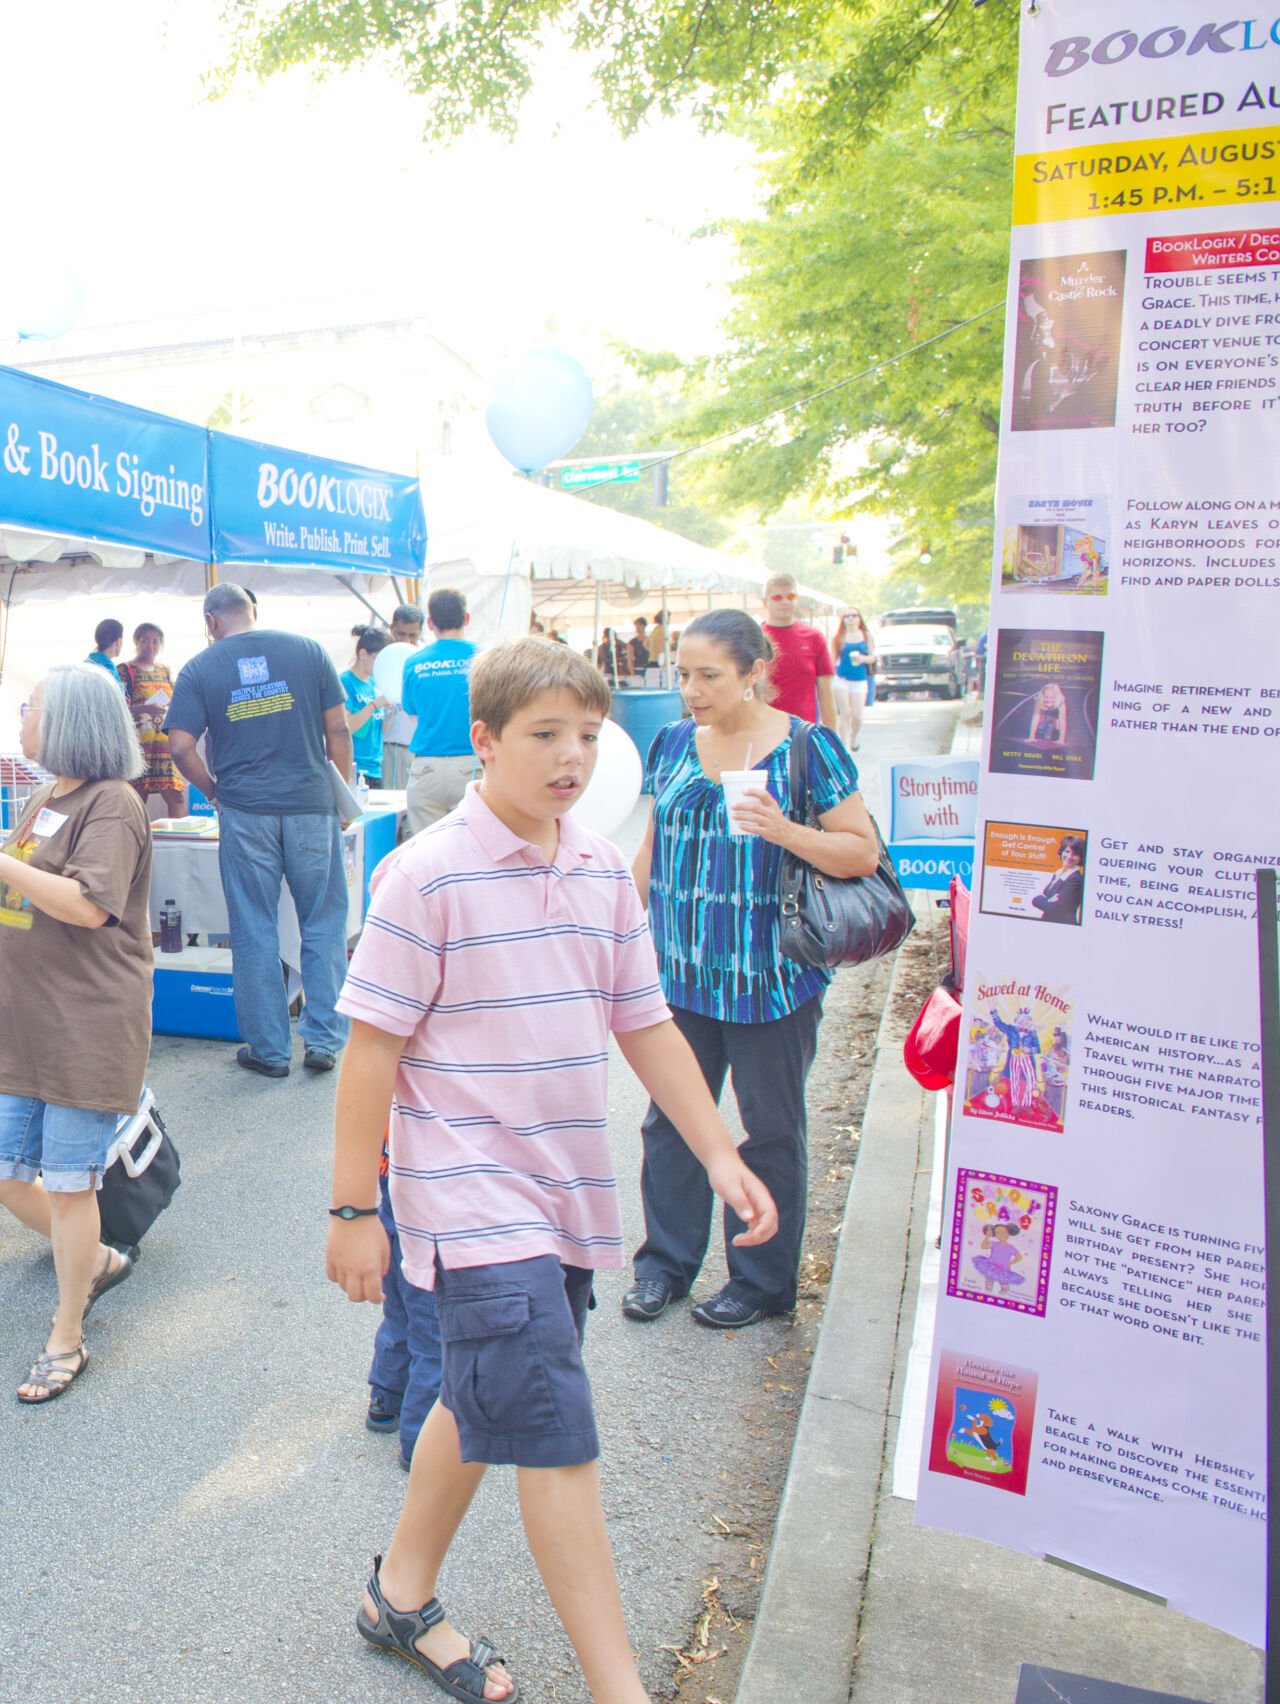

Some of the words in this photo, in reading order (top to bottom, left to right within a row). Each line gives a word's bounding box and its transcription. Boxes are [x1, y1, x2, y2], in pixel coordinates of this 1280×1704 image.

[1044, 17, 1280, 78] BOOKL
[1046, 91, 1224, 134] FEATURED
[1032, 152, 1168, 183] SATURDAY,
[1178, 141, 1280, 168] AUGUS
[1088, 189, 1143, 210] 1:45
[1153, 184, 1204, 204] P.M.
[1153, 238, 1236, 253] BOOKLOGIX
[1192, 253, 1252, 264] WRITERS
[1144, 276, 1213, 289] TROUBLE
[1217, 272, 1266, 285] SEEMS
[1086, 286, 1118, 298] Rock
[1142, 297, 1195, 310] GRACE.
[1199, 294, 1231, 307] THIS
[1234, 293, 1271, 305] TIME,
[1140, 321, 1149, 331] A
[1154, 318, 1212, 330] DEADLY
[1216, 315, 1251, 327] DIVE
[1137, 362, 1149, 372] IS
[1156, 361, 1178, 371] ON
[1185, 354, 1278, 370] EVERYONE'S
[1134, 402, 1182, 413] TRUTH
[1193, 400, 1251, 412] BEFORE
[1132, 424, 1160, 434] HER
[1166, 419, 1207, 432] TOO?
[2, 422, 32, 477] &
[38, 430, 111, 493] Book
[117, 453, 204, 527] Signing
[1127, 499, 1182, 511] FOLLOW
[1185, 501, 1232, 511] ALONG
[1235, 501, 1255, 510] ON
[1258, 501, 1266, 510] A
[1125, 520, 1141, 530] AS
[1151, 518, 1198, 530] KARYN
[1208, 520, 1258, 529] LEAVES
[264, 521, 297, 548] Write.
[300, 525, 342, 553] Publish.
[344, 531, 369, 556] Print.
[372, 535, 391, 558] Sell.
[1124, 539, 1245, 548] NEIGHBORHOODS
[1123, 558, 1196, 567] HORIZONS.
[1206, 556, 1276, 567] INCLUDES
[1121, 576, 1151, 586] FIND
[1155, 577, 1183, 586] AND
[1187, 577, 1230, 586] PAPER
[1040, 642, 1063, 652] THE
[1013, 652, 1088, 663] DECATHLON
[1038, 663, 1061, 673] LIFE
[1114, 680, 1163, 694] IMAGINE
[1172, 685, 1252, 697] RETIREMENT
[1111, 719, 1158, 730] RATHER
[1162, 722, 1197, 732] THAN
[1202, 724, 1228, 734] THE
[1232, 725, 1259, 736] END
[899, 776, 978, 801] Storytime
[923, 803, 959, 826] with
[1017, 842, 1046, 851] Control
[1101, 837, 1128, 850] GET
[1137, 844, 1164, 854] AND
[1173, 848, 1204, 859] STAY
[1099, 857, 1157, 872] QUERING
[1168, 865, 1204, 877] YOUR
[1095, 909, 1129, 922] DAILY
[1133, 914, 1184, 929] STRESS!
[977, 980, 1016, 1001] Saved
[1018, 984, 1031, 997] at
[1035, 984, 1071, 1014] Home
[1085, 1031, 1150, 1053] AMERICAN
[1087, 1013, 1124, 1031] WHAT
[1127, 1023, 1173, 1039] WOULD
[1175, 1032, 1187, 1041] IT
[1190, 1034, 1206, 1045] BE
[1209, 1037, 1239, 1050] LIKE
[1242, 1042, 1261, 1053] TO
[1079, 1099, 1135, 1119] READERS.
[1081, 1082, 1107, 1095] THIS
[1113, 1089, 1185, 1112] HISTORICAL
[1191, 1105, 1250, 1123] FANTASY
[1069, 1200, 1119, 1222] SAXONY
[1122, 1214, 1165, 1234] GRACE
[1168, 1227, 1180, 1237] IS
[1183, 1230, 1240, 1251] TURNING
[1068, 1218, 1096, 1233] WILL
[1100, 1226, 1123, 1240] SHE
[1127, 1234, 1150, 1247] GET
[1155, 1241, 1192, 1257] FROM
[1196, 1251, 1222, 1264] HER
[1060, 1298, 1077, 1309] OF
[1080, 1302, 1110, 1317] THAT
[1113, 1312, 1149, 1330] WORD
[1152, 1324, 1179, 1339] ONE
[1183, 1332, 1204, 1346] BIT.
[1061, 1282, 1115, 1304] BECAUSE
[1118, 1297, 1141, 1311] SHE
[1144, 1305, 1199, 1327] DOESN'T
[1202, 1321, 1231, 1335] LIKE
[1235, 1328, 1261, 1342] THE
[1048, 1408, 1077, 1426] TAKE
[1088, 1423, 1095, 1431] A
[1107, 1427, 1139, 1445] WALK
[1151, 1442, 1183, 1459] WITH
[1195, 1454, 1256, 1481] HERSHEY
[1045, 1426, 1089, 1446] BEAGLE
[1096, 1440, 1112, 1452] TO
[1118, 1448, 1178, 1474] DISCOVER
[1185, 1469, 1208, 1484] THE
[1042, 1457, 1066, 1470] AND
[1069, 1465, 1164, 1503] PERSEVERANCE.
